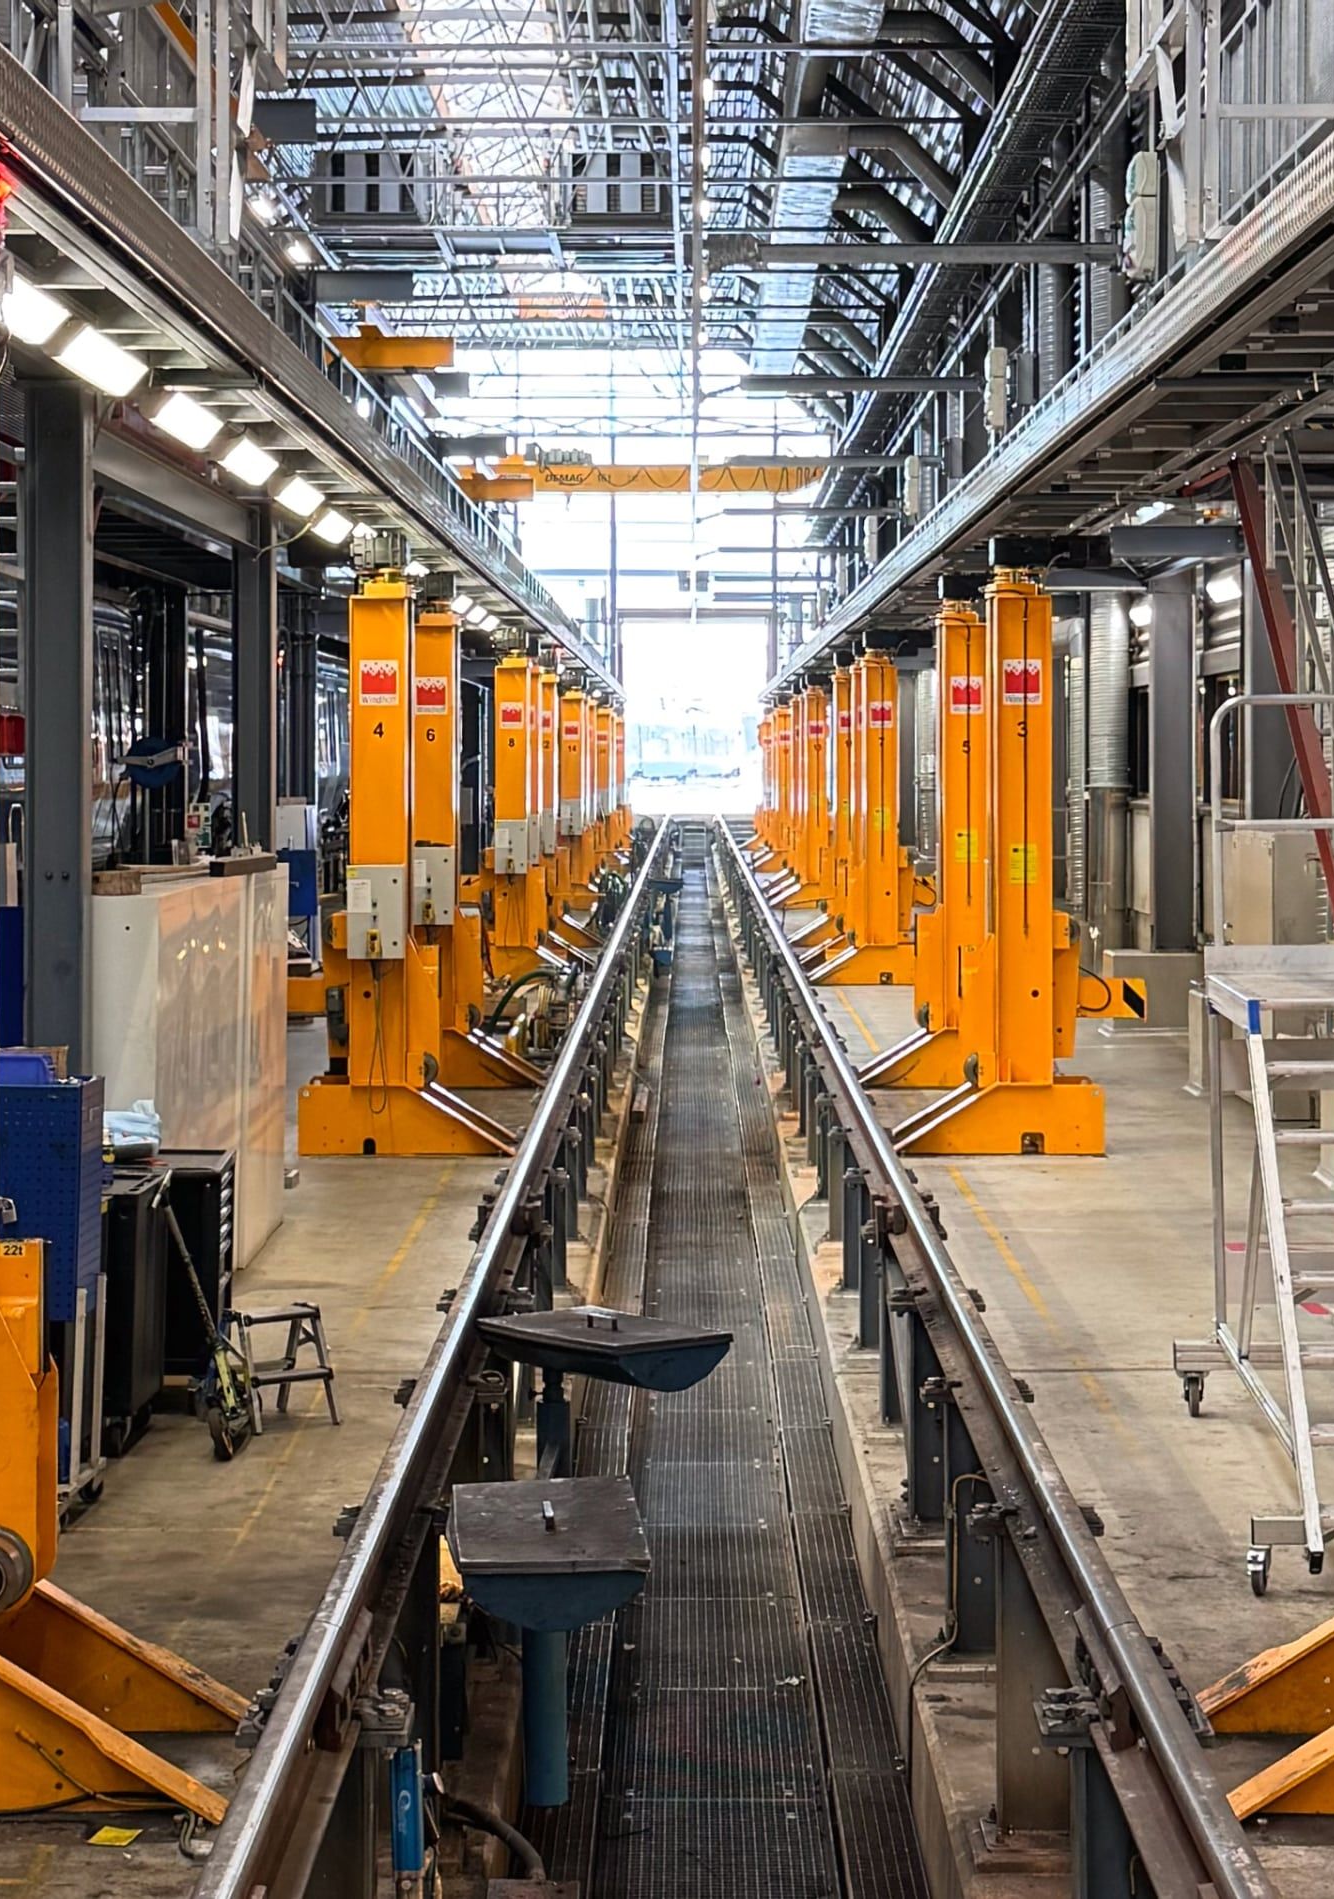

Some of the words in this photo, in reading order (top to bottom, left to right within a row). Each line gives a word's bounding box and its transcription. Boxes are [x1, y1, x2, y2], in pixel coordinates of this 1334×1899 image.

[373, 722, 384, 738] 4
[427, 728, 436, 742] 6
[1017, 721, 1028, 738] 3
[508, 738, 515, 748] 8
[567, 745, 577, 753] 14
[962, 740, 971, 754] 5
[3, 1244, 23, 1256] 22t
